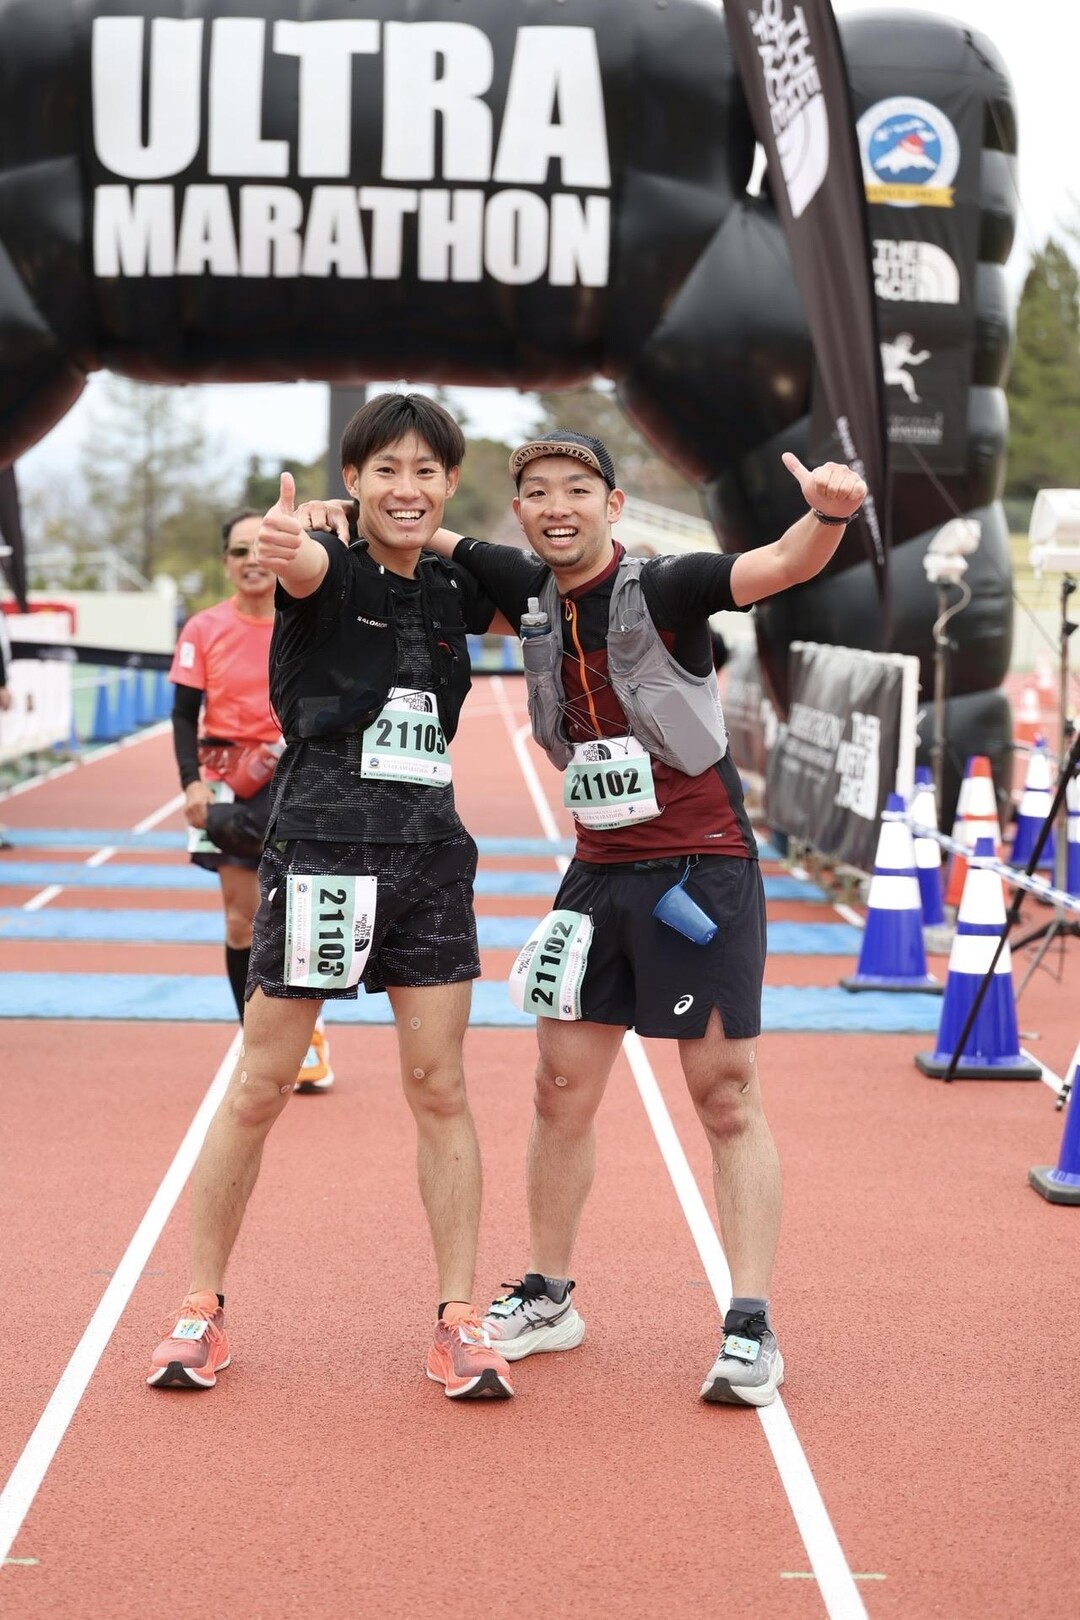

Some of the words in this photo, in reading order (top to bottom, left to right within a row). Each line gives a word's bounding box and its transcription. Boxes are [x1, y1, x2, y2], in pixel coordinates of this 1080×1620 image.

[762, 0, 804, 128] ORTH
[92, 16, 612, 188] ULTRA
[94, 184, 611, 287] MARATHON
[551, 446, 577, 455] YOUR
[577, 451, 593, 465] WAY
[403, 697, 425, 707] NORTH
[409, 703, 425, 712] FACE
[376, 719, 445, 755] 21103
[571, 768, 642, 801] 21102
[317, 889, 347, 976] 21103
[359, 913, 368, 939] NORTH
[531, 921, 573, 1006] 21102
